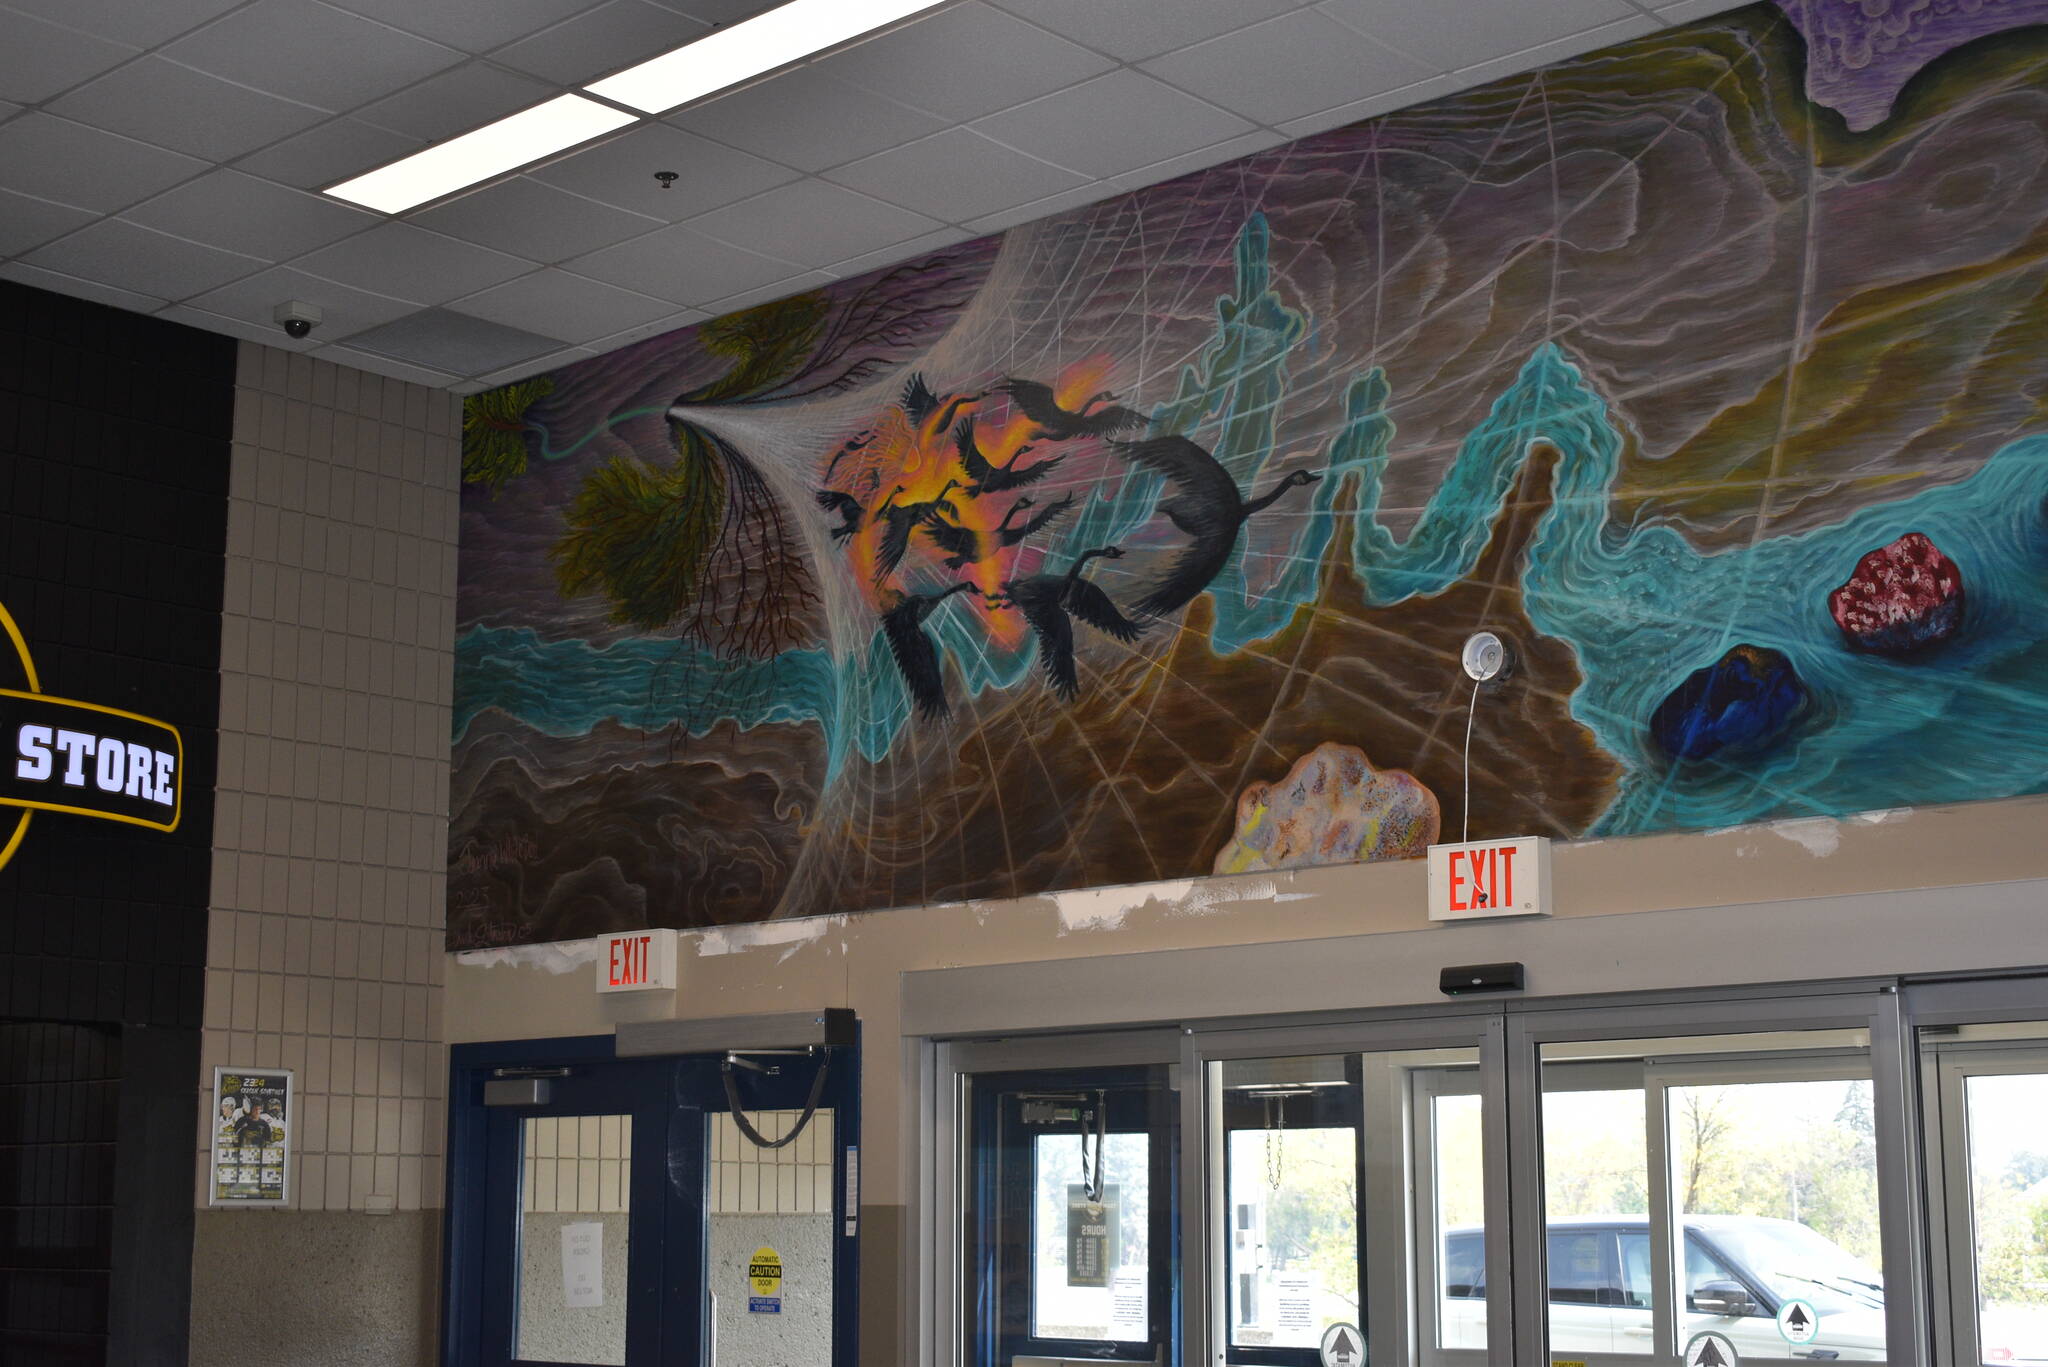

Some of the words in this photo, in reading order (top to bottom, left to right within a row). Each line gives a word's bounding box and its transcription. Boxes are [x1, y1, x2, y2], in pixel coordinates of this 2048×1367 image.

[17, 724, 175, 806] STORE
[1449, 846, 1517, 911] EXIT
[609, 936, 651, 986] EXIT
[750, 1266, 780, 1276] CAUTION
[752, 1255, 779, 1263] AUTOMATIC
[757, 1278, 773, 1287] DOOR
